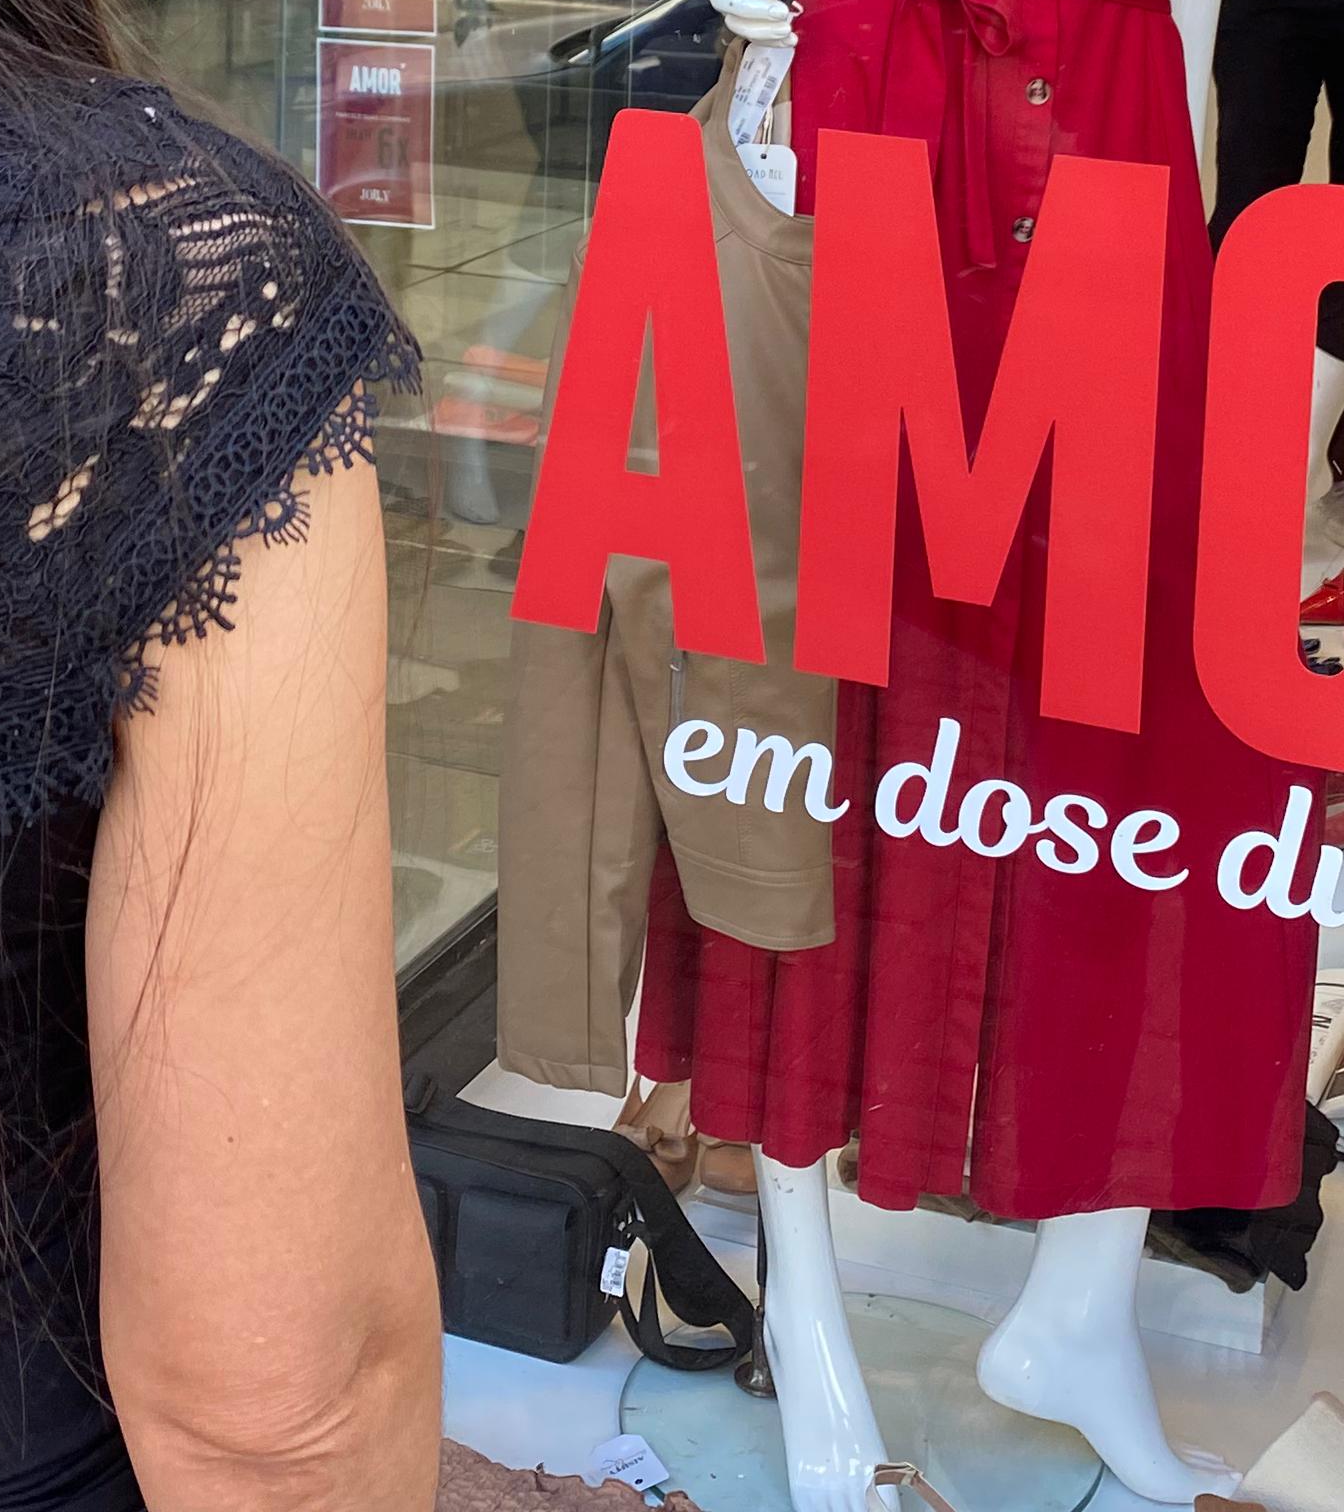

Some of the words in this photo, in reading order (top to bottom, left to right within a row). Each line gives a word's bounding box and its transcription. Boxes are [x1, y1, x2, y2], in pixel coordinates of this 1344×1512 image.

[348, 64, 402, 97] AMOR
[662, 717, 847, 824] em
[874, 716, 1190, 892] dose
